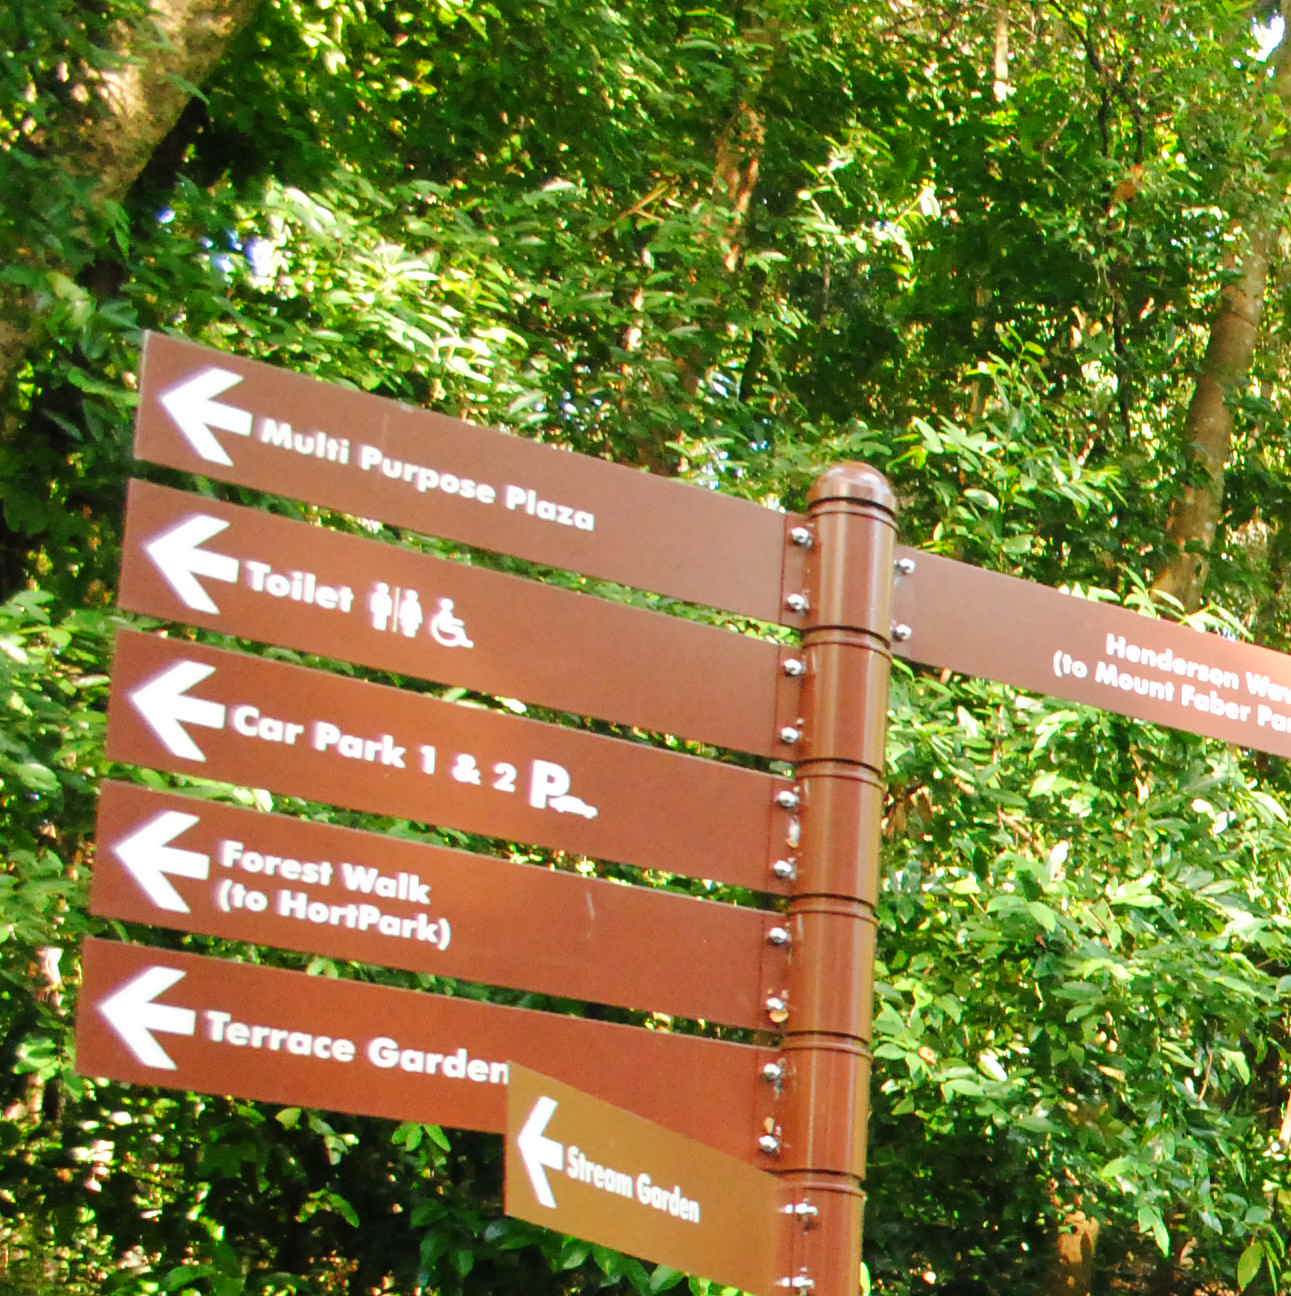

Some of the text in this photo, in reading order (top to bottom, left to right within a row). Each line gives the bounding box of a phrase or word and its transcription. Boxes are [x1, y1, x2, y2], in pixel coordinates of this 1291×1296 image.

[259, 419, 595, 532] Multi Purpose Plaza
[245, 560, 354, 613] Toilet
[1052, 651, 1088, 678] (to
[1095, 662, 1175, 701] Mount
[1181, 684, 1250, 722] Faber
[1106, 634, 1239, 689] Henderson
[230, 705, 304, 745] Car
[314, 721, 406, 769] Park
[419, 745, 435, 775] 1
[451, 753, 481, 786] &
[492, 762, 517, 793] 2
[219, 840, 431, 904] Forest Walk
[217, 880, 451, 950] (to HortPark)
[204, 1010, 509, 1085] Terrace Garden
[566, 1145, 701, 1223] Stream Garden
